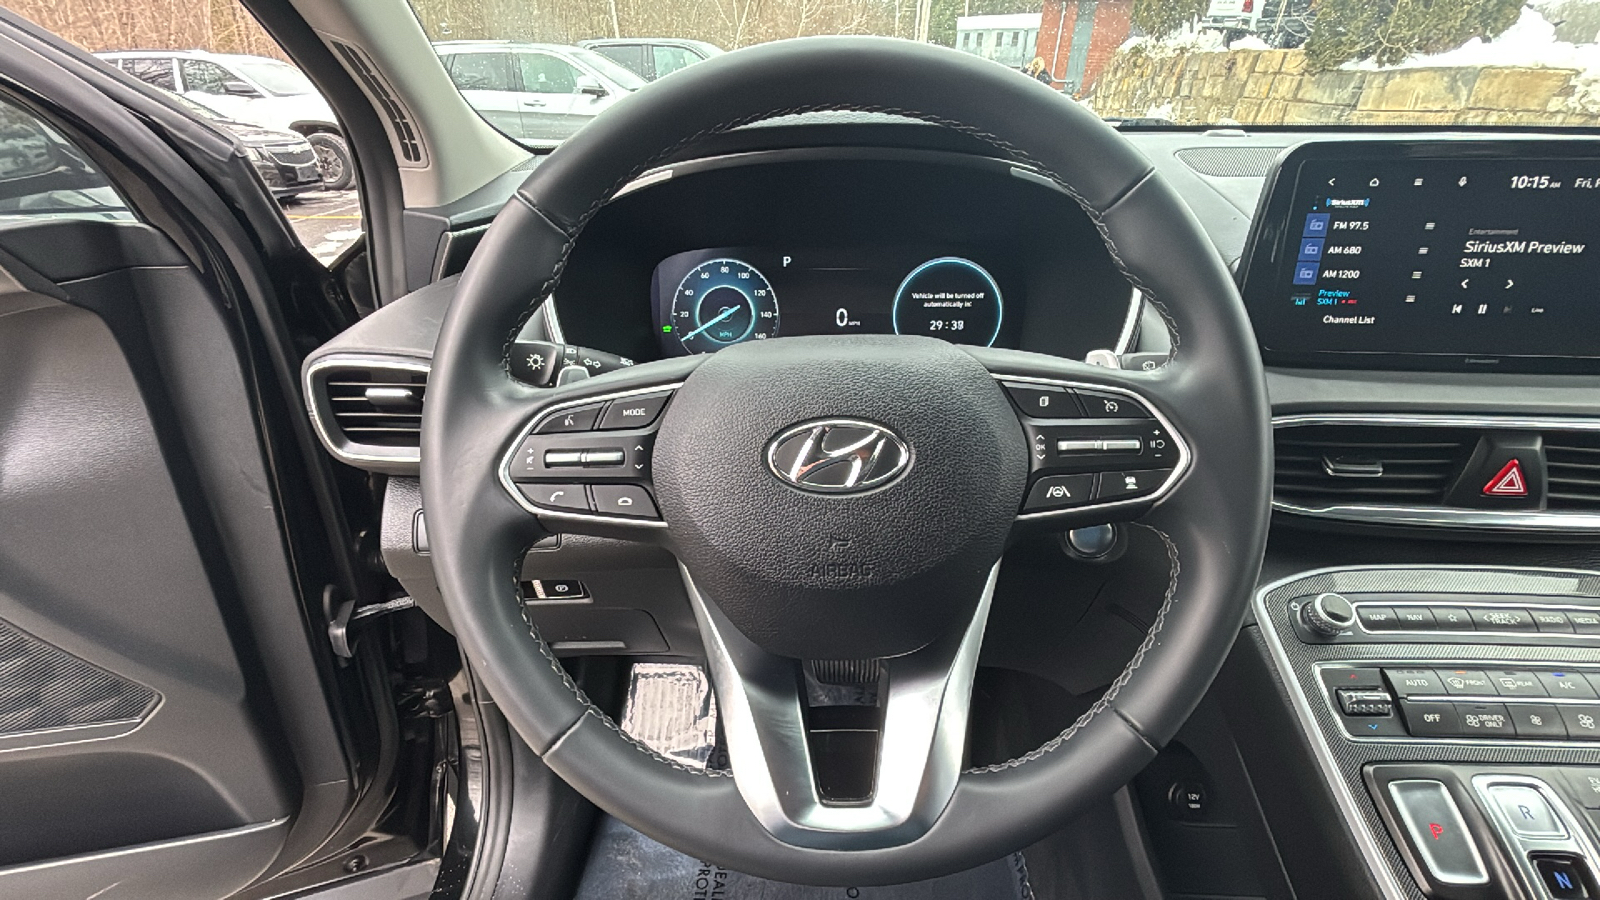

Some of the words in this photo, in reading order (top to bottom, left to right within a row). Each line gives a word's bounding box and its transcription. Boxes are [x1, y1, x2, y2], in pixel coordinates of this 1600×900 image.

[1510, 175, 1550, 189] 10:15
[1574, 177, 1592, 189] Fri,
[1333, 221, 1347, 230] FM
[1349, 221, 1370, 231] 97.5
[1327, 246, 1342, 254] AM
[1343, 246, 1362, 255] 680
[1463, 240, 1526, 253] SiriusXM
[1527, 241, 1585, 253] Preview
[782, 256, 792, 268] P
[1459, 257, 1483, 267] SXM
[1484, 258, 1491, 267] 1
[720, 266, 730, 274] 80
[1322, 269, 1338, 278] AM
[1338, 270, 1361, 279] 1200
[1318, 289, 1351, 297] Preview
[835, 307, 848, 327] 0
[1322, 315, 1357, 324] Channel
[1358, 316, 1376, 324] List
[622, 408, 646, 416] MODE
[1406, 679, 1428, 687] AUTO
[1424, 713, 1440, 723] OFF
[1517, 804, 1535, 820] R
[1428, 823, 1444, 840] P
[1553, 871, 1574, 889] N
